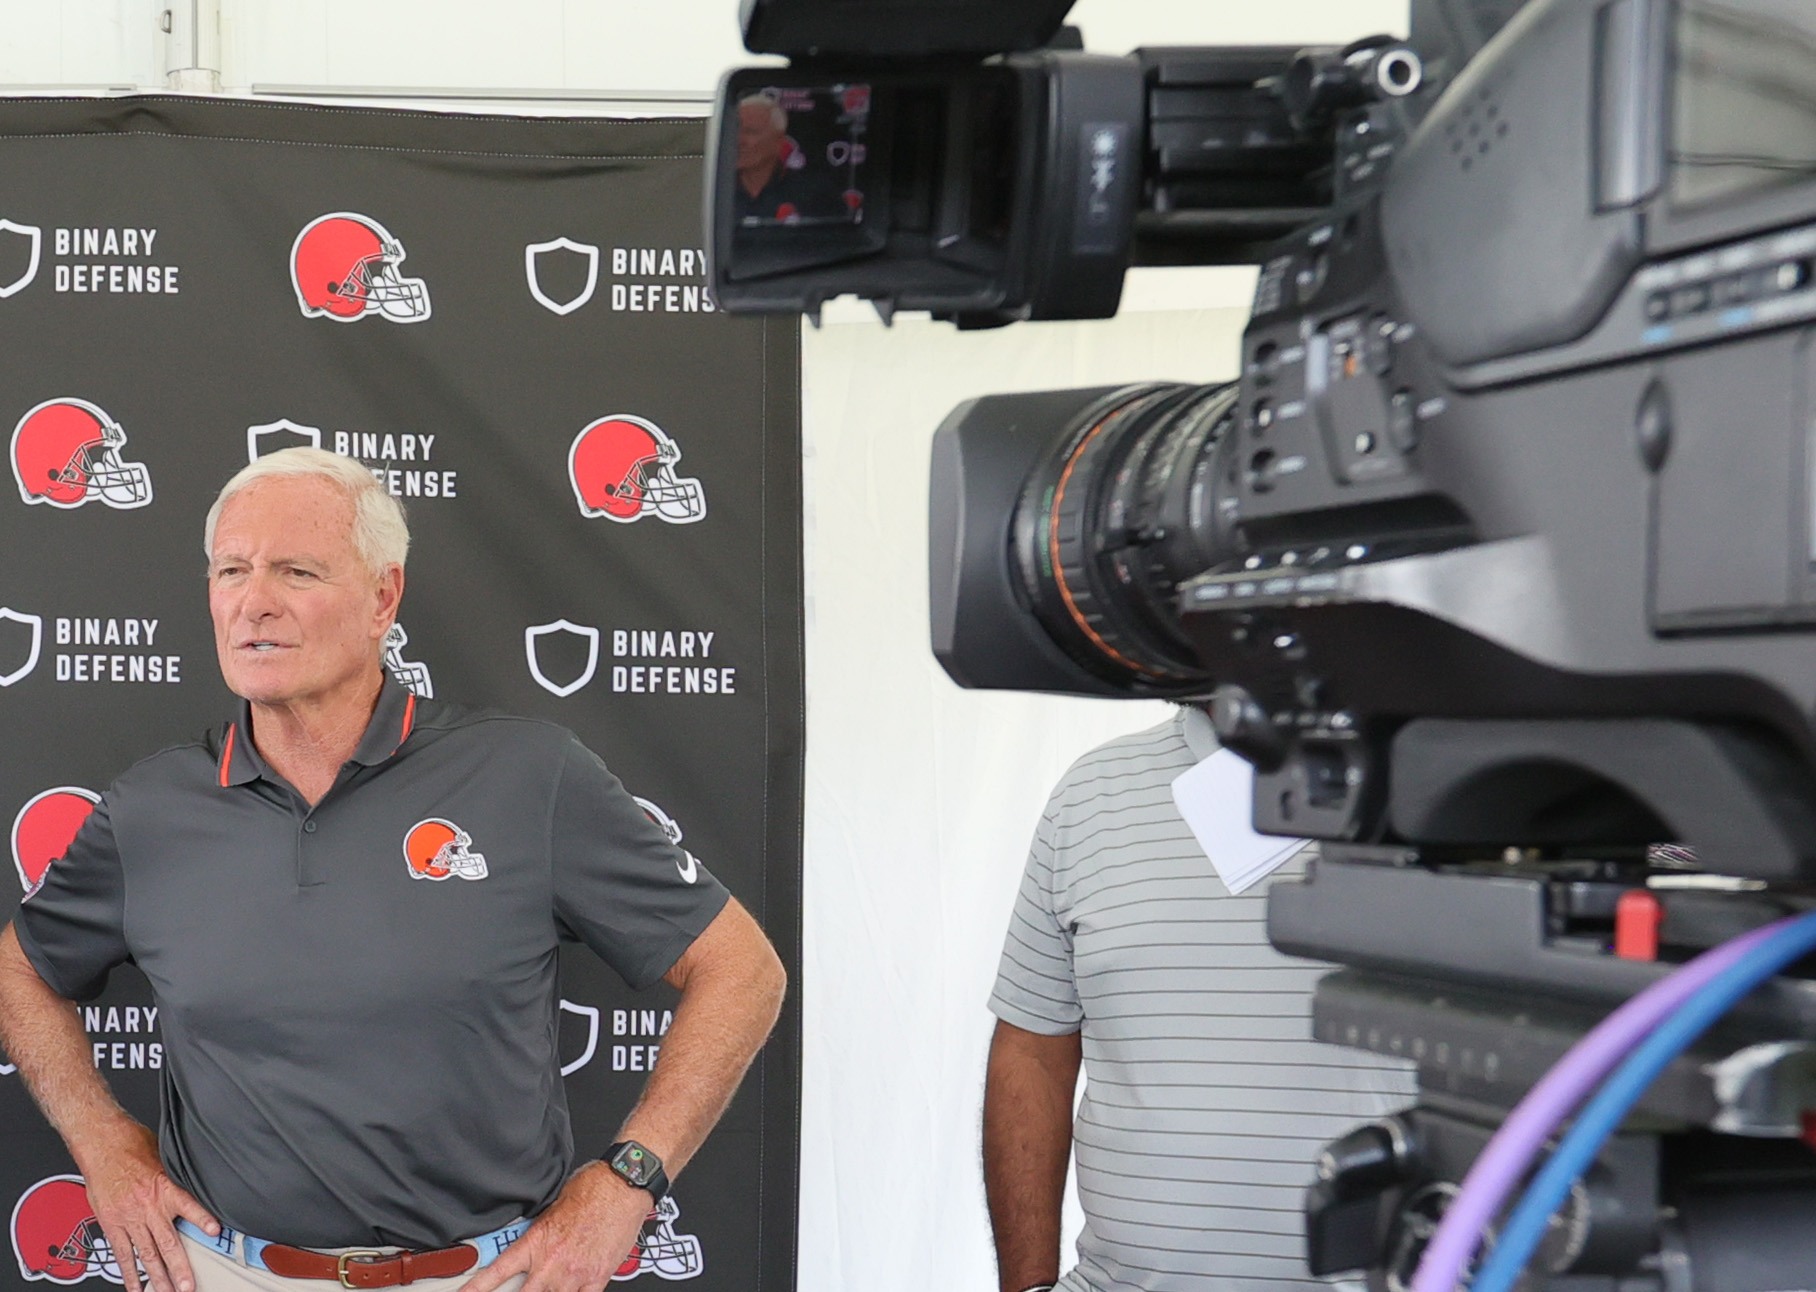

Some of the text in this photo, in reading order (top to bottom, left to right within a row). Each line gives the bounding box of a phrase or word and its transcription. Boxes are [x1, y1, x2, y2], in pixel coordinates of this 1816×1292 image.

[55, 228, 157, 256] BINARY
[55, 265, 179, 294] DEFENSE
[612, 284, 717, 312] DEFENS
[334, 430, 435, 461] BINARY
[370, 469, 457, 496] FENSE
[56, 618, 158, 646] BINARY
[613, 630, 714, 658] BINARY
[56, 654, 181, 683] DEFENSE
[613, 666, 735, 694] DEFENSE
[77, 1006, 158, 1033] NARY
[613, 1010, 672, 1036] BINA
[93, 1043, 163, 1069] FENS
